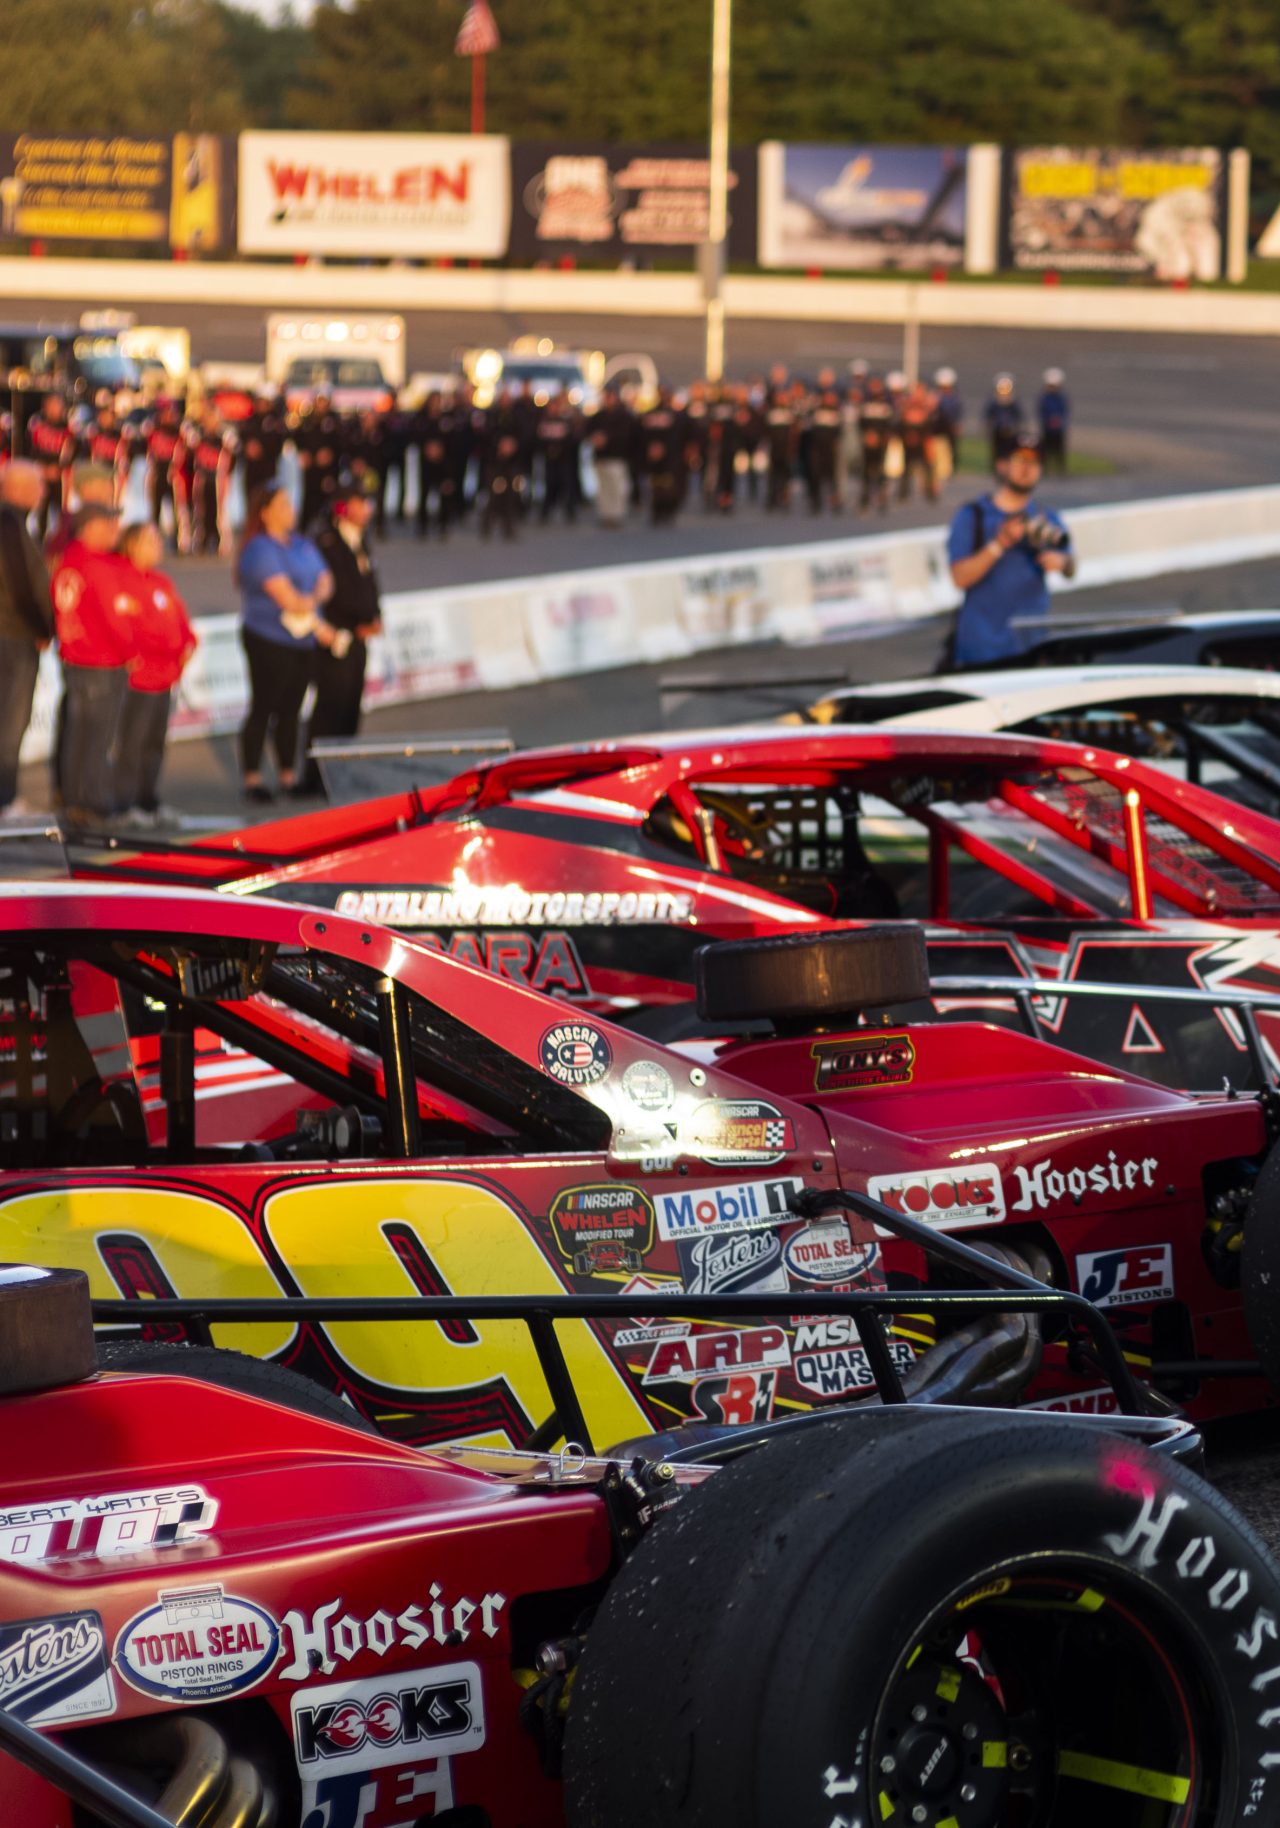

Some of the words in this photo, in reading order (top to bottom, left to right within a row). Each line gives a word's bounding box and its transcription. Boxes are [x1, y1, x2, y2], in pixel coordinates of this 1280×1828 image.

[268, 157, 473, 205] WHELEN
[484, 892, 694, 926] MOTORSPORTS
[547, 1024, 598, 1048] NASCAR
[550, 1059, 606, 1084] SALUTES
[879, 1177, 995, 1214] KOOKS
[1011, 1151, 1158, 1212] Hoosier
[556, 1205, 647, 1231] WHELEN
[583, 1191, 635, 1210] NASCAR
[663, 1186, 759, 1229] Mobil
[773, 1184, 787, 1211] 1
[575, 1230, 613, 1241] MODIFIED
[614, 1228, 635, 1239] TOUR
[669, 1227, 700, 1237] OFFICIAL
[704, 1223, 731, 1232] MOTOR
[733, 1220, 744, 1228] OIL
[754, 1212, 799, 1225] LUBRICANT
[688, 1230, 780, 1293] Jostens
[793, 1242, 832, 1262] TOTAL
[1082, 1247, 1165, 1303] JE
[1108, 1287, 1173, 1304] PISTONS
[648, 1333, 784, 1376] ARP
[797, 1342, 912, 1383] QUARR
[132, 1630, 204, 1667] TOTAL
[206, 1622, 264, 1657] SEAL
[278, 1582, 506, 1681] Hoosier
[0, 1618, 100, 1690] stens
[160, 1666, 204, 1681] PISTON
[208, 1660, 244, 1675] RINGS
[181, 1686, 209, 1696] Phoenix,
[210, 1684, 232, 1694] Arizona
[199, 1676, 213, 1684] Seal,
[65, 1702, 89, 1712] SINCE
[296, 1679, 472, 1764] KOOKS
[919, 1737, 948, 1786] FURY
